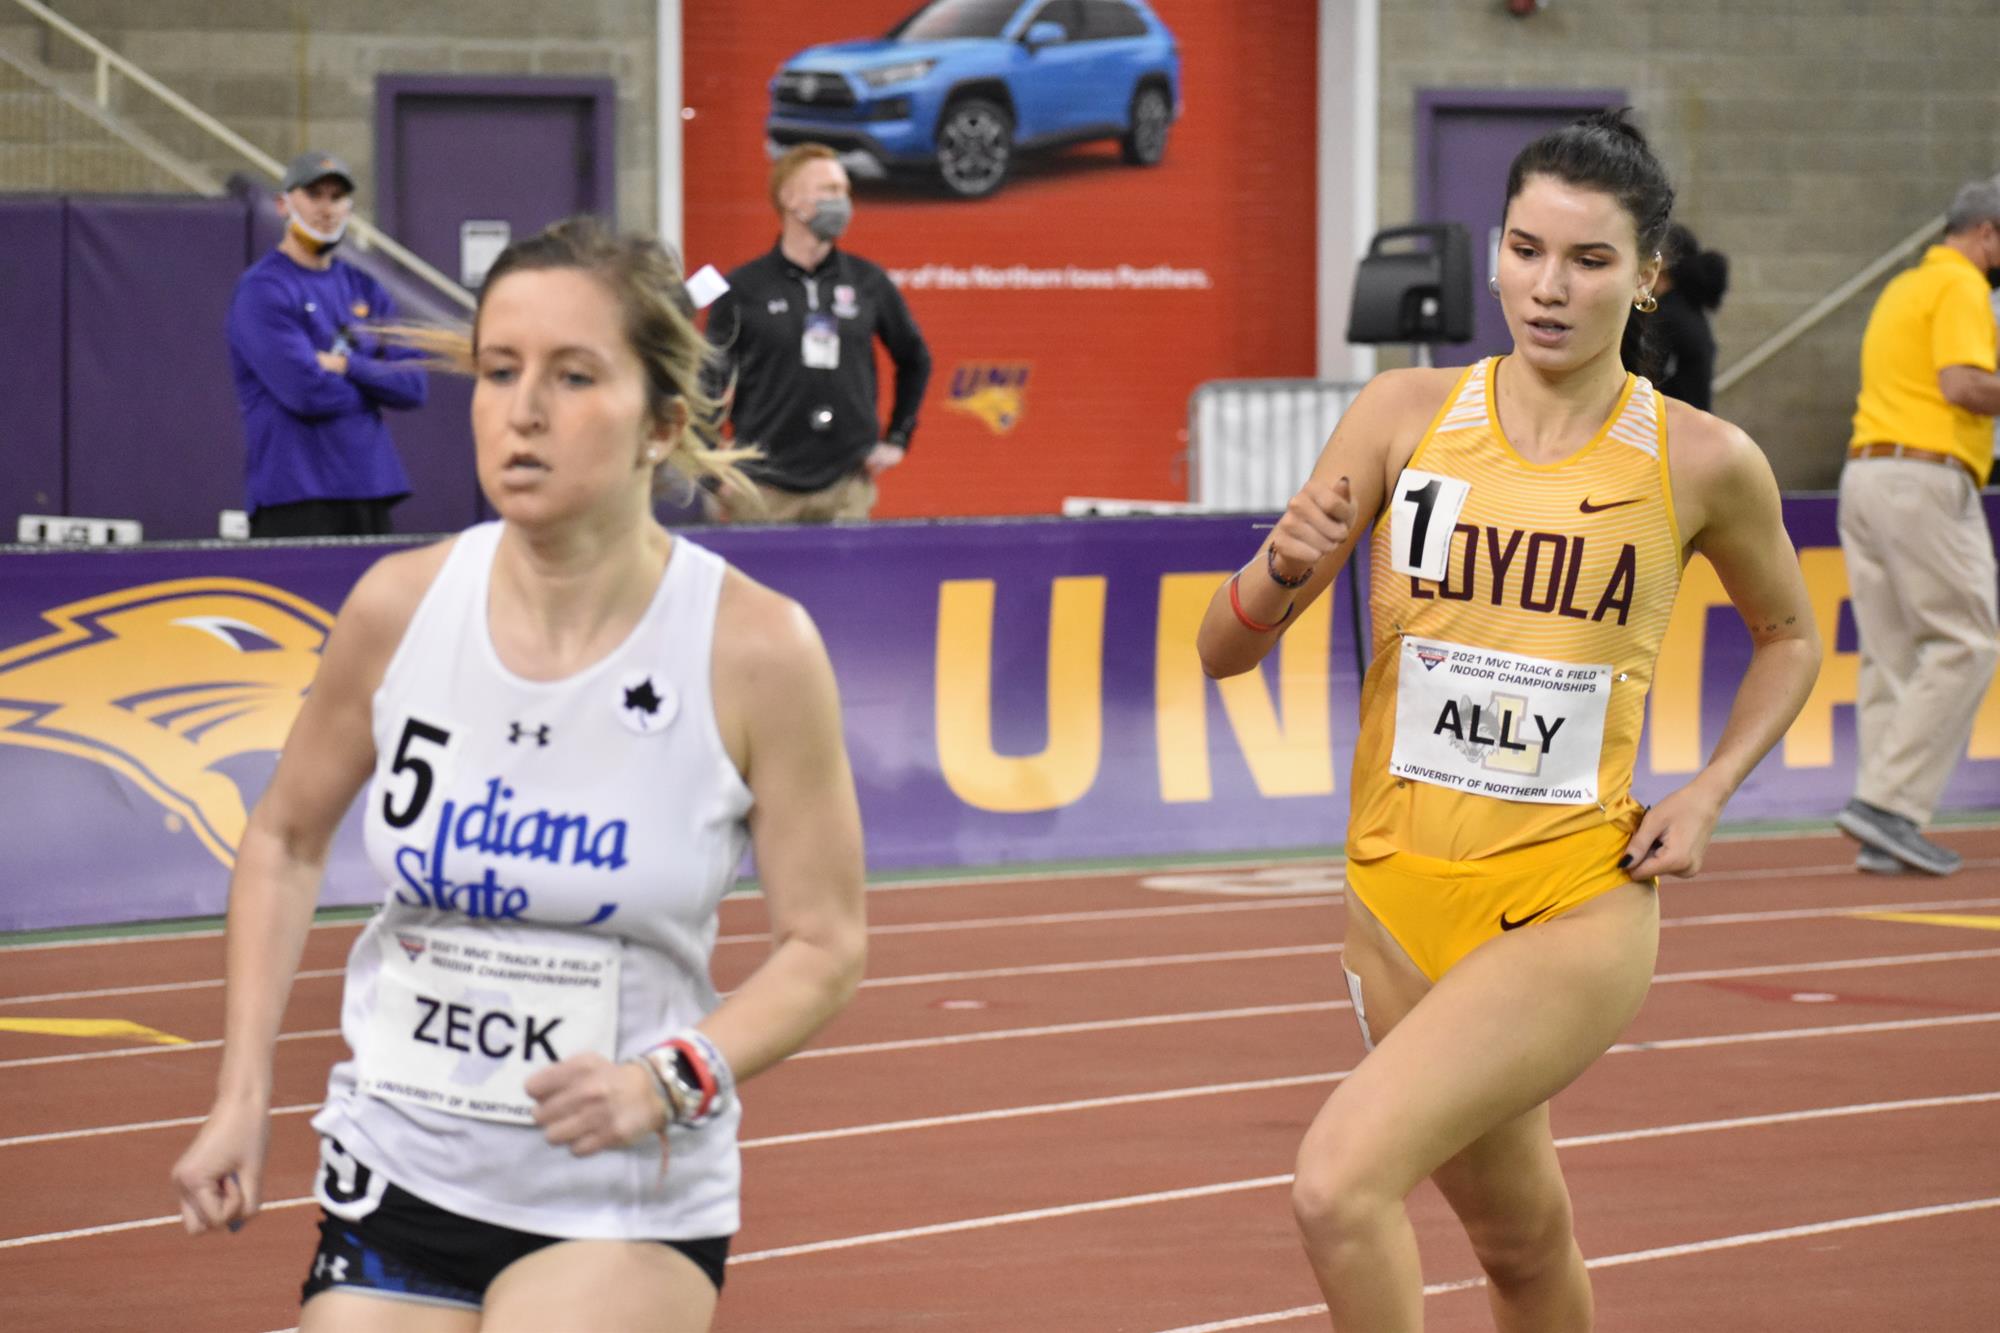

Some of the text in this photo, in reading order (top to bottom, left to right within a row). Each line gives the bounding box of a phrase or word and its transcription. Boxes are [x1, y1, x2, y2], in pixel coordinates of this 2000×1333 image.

[951, 364, 1030, 399] UNI
[1404, 479, 1442, 569] 1
[1449, 664, 1597, 694] INDOOR CHAMPIONSHIPS
[1451, 651, 1482, 665] 2021
[1485, 657, 1510, 670] MVC
[1515, 662, 1550, 677] TRACK
[1555, 669, 1563, 678] &
[1566, 670, 1597, 680] FIELD
[1433, 699, 1566, 754] ALLY
[382, 716, 452, 829] 5
[1403, 764, 1583, 799] UNIVERSITY OF NORTHERN IOWA
[394, 845, 531, 922] State
[413, 995, 564, 1062] ZECK
